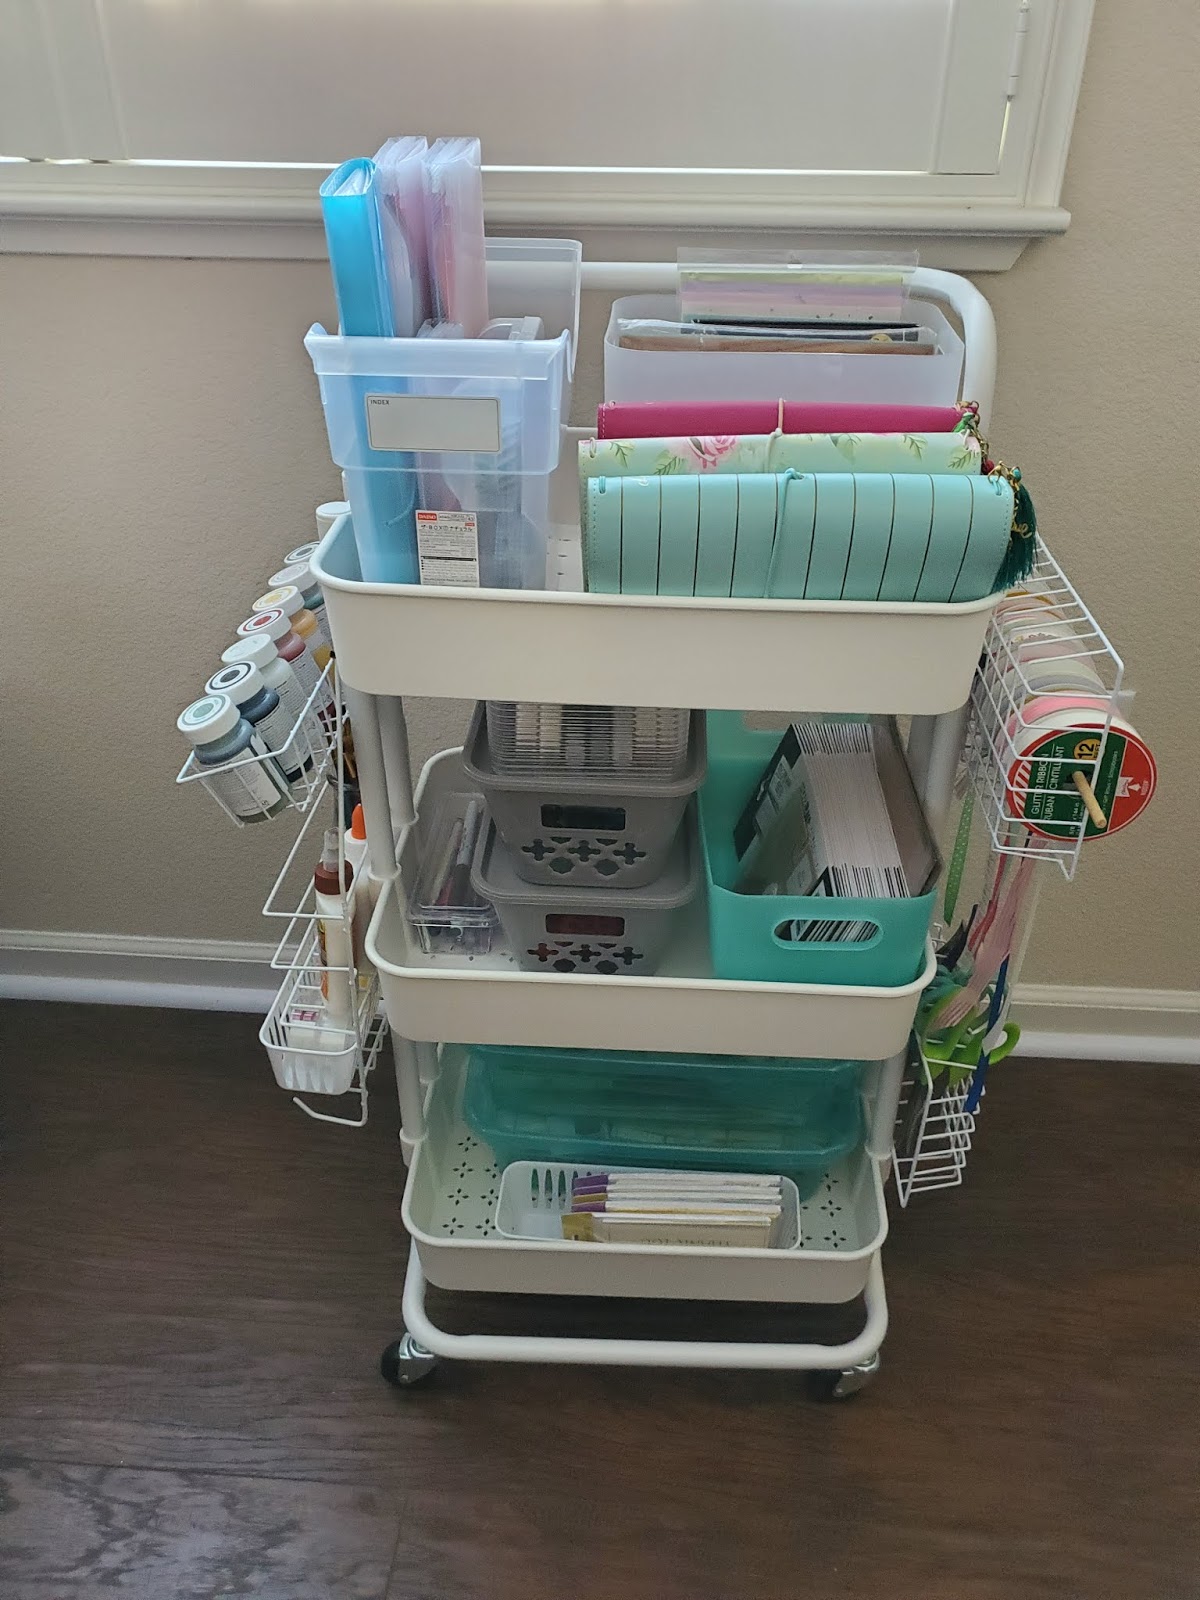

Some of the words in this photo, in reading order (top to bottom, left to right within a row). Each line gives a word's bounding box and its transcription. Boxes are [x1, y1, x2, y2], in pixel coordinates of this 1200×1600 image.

[1077, 743, 1095, 759] 12
[1035, 753, 1049, 784] RIBBON
[1048, 746, 1065, 792] CINTILLNT
[1031, 785, 1044, 815] GLITTR
